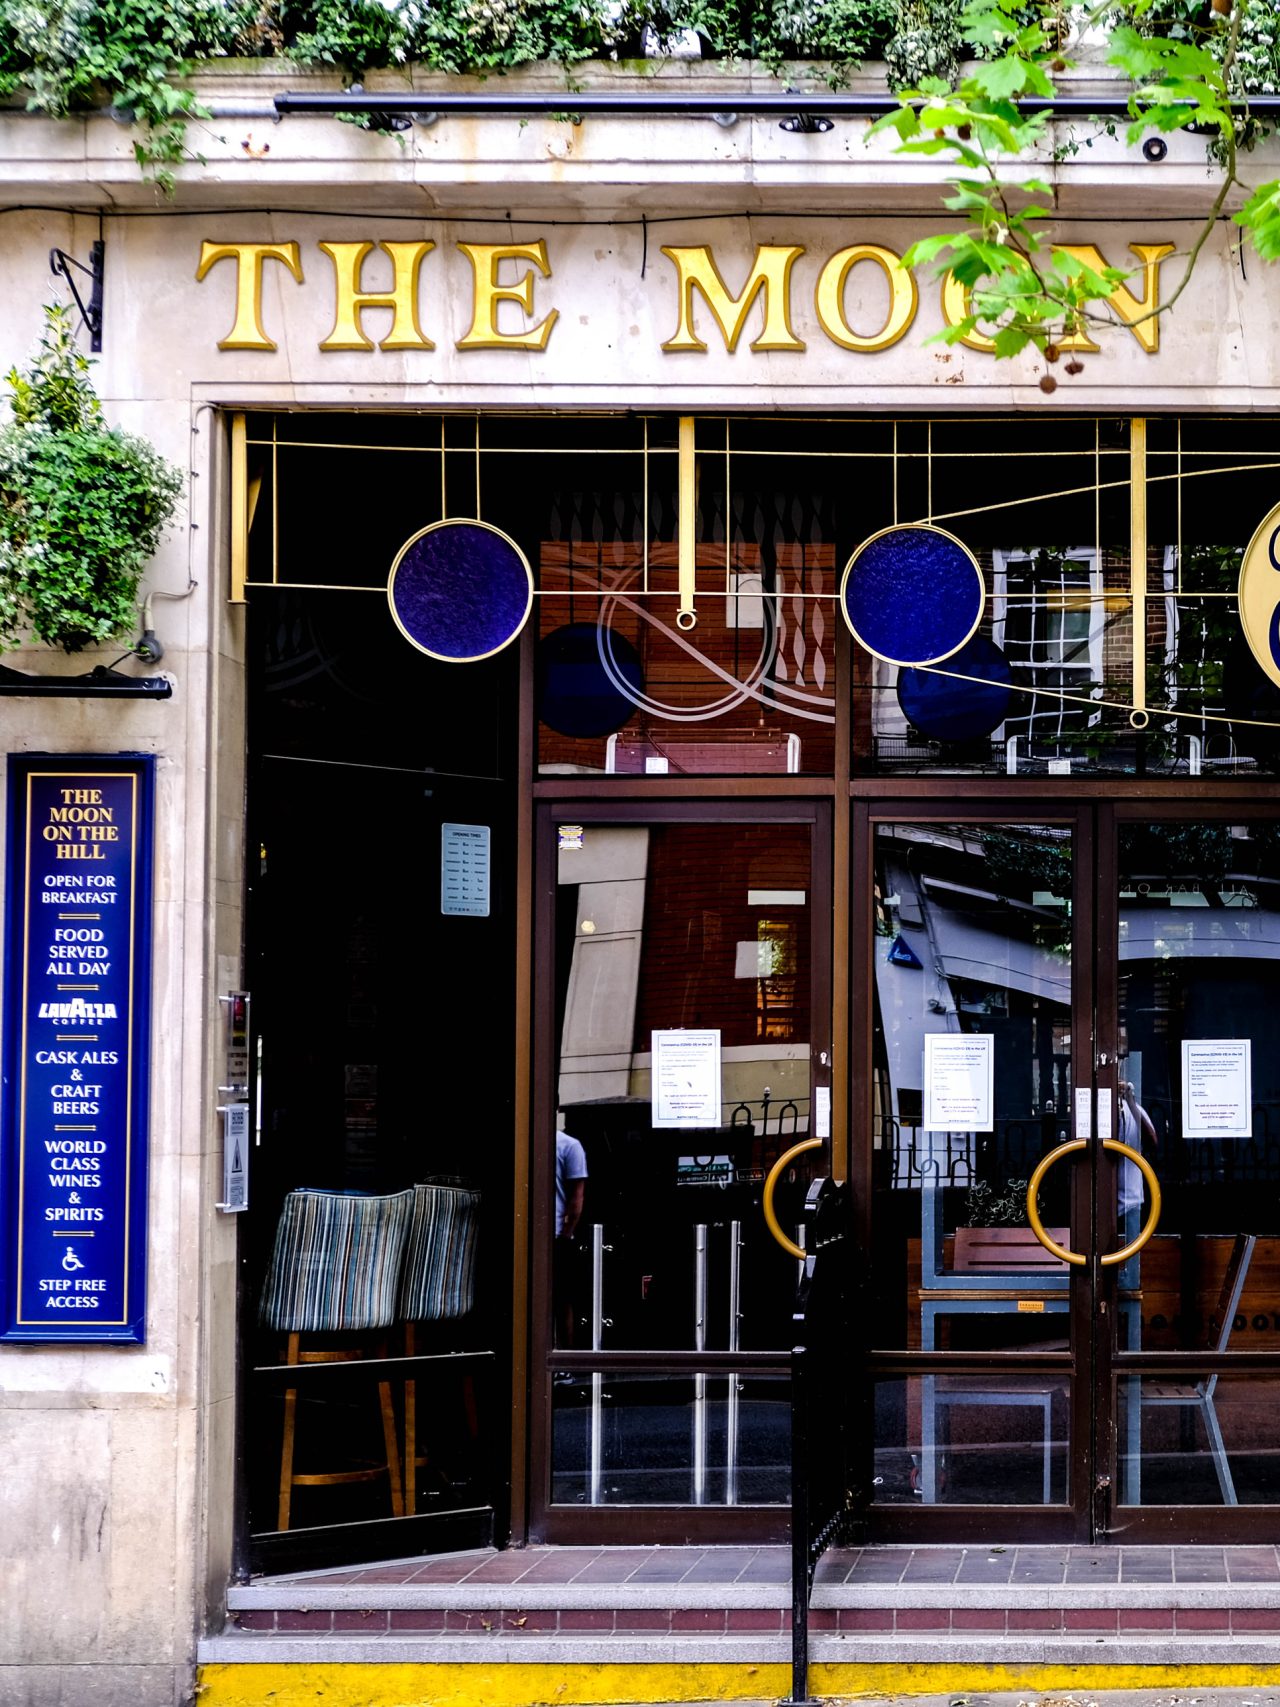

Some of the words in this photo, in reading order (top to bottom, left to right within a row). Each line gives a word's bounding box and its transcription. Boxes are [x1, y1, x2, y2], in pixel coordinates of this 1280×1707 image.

[195, 238, 559, 352] THE
[61, 789, 102, 804] THE
[50, 807, 113, 823] MOON
[43, 826, 74, 841] ON
[77, 826, 118, 841] THE
[56, 844, 105, 859] HILL
[44, 875, 83, 887] OPEN
[87, 875, 116, 887] FOR
[42, 892, 117, 904] BREAKFAST
[55, 929, 104, 942] FOOD
[49, 946, 108, 959] SERVED
[46, 963, 75, 975] ALL
[78, 963, 111, 976] DAY
[38, 998, 118, 1018] LAVAZZA
[35, 1051, 78, 1064] CASK
[80, 1051, 118, 1064] ALES
[70, 1068, 83, 1081] &
[50, 1085, 102, 1097] CRAFT
[53, 1102, 99, 1115] BEERS
[44, 1141, 107, 1154] WORLD
[50, 1157, 100, 1171] CLASS
[48, 1174, 101, 1188] WINES
[68, 1191, 82, 1204] &
[45, 1208, 104, 1222] SPIRITS
[39, 1279, 71, 1292] STEP
[74, 1279, 107, 1291] FREE
[46, 1296, 99, 1308] ACCESS
